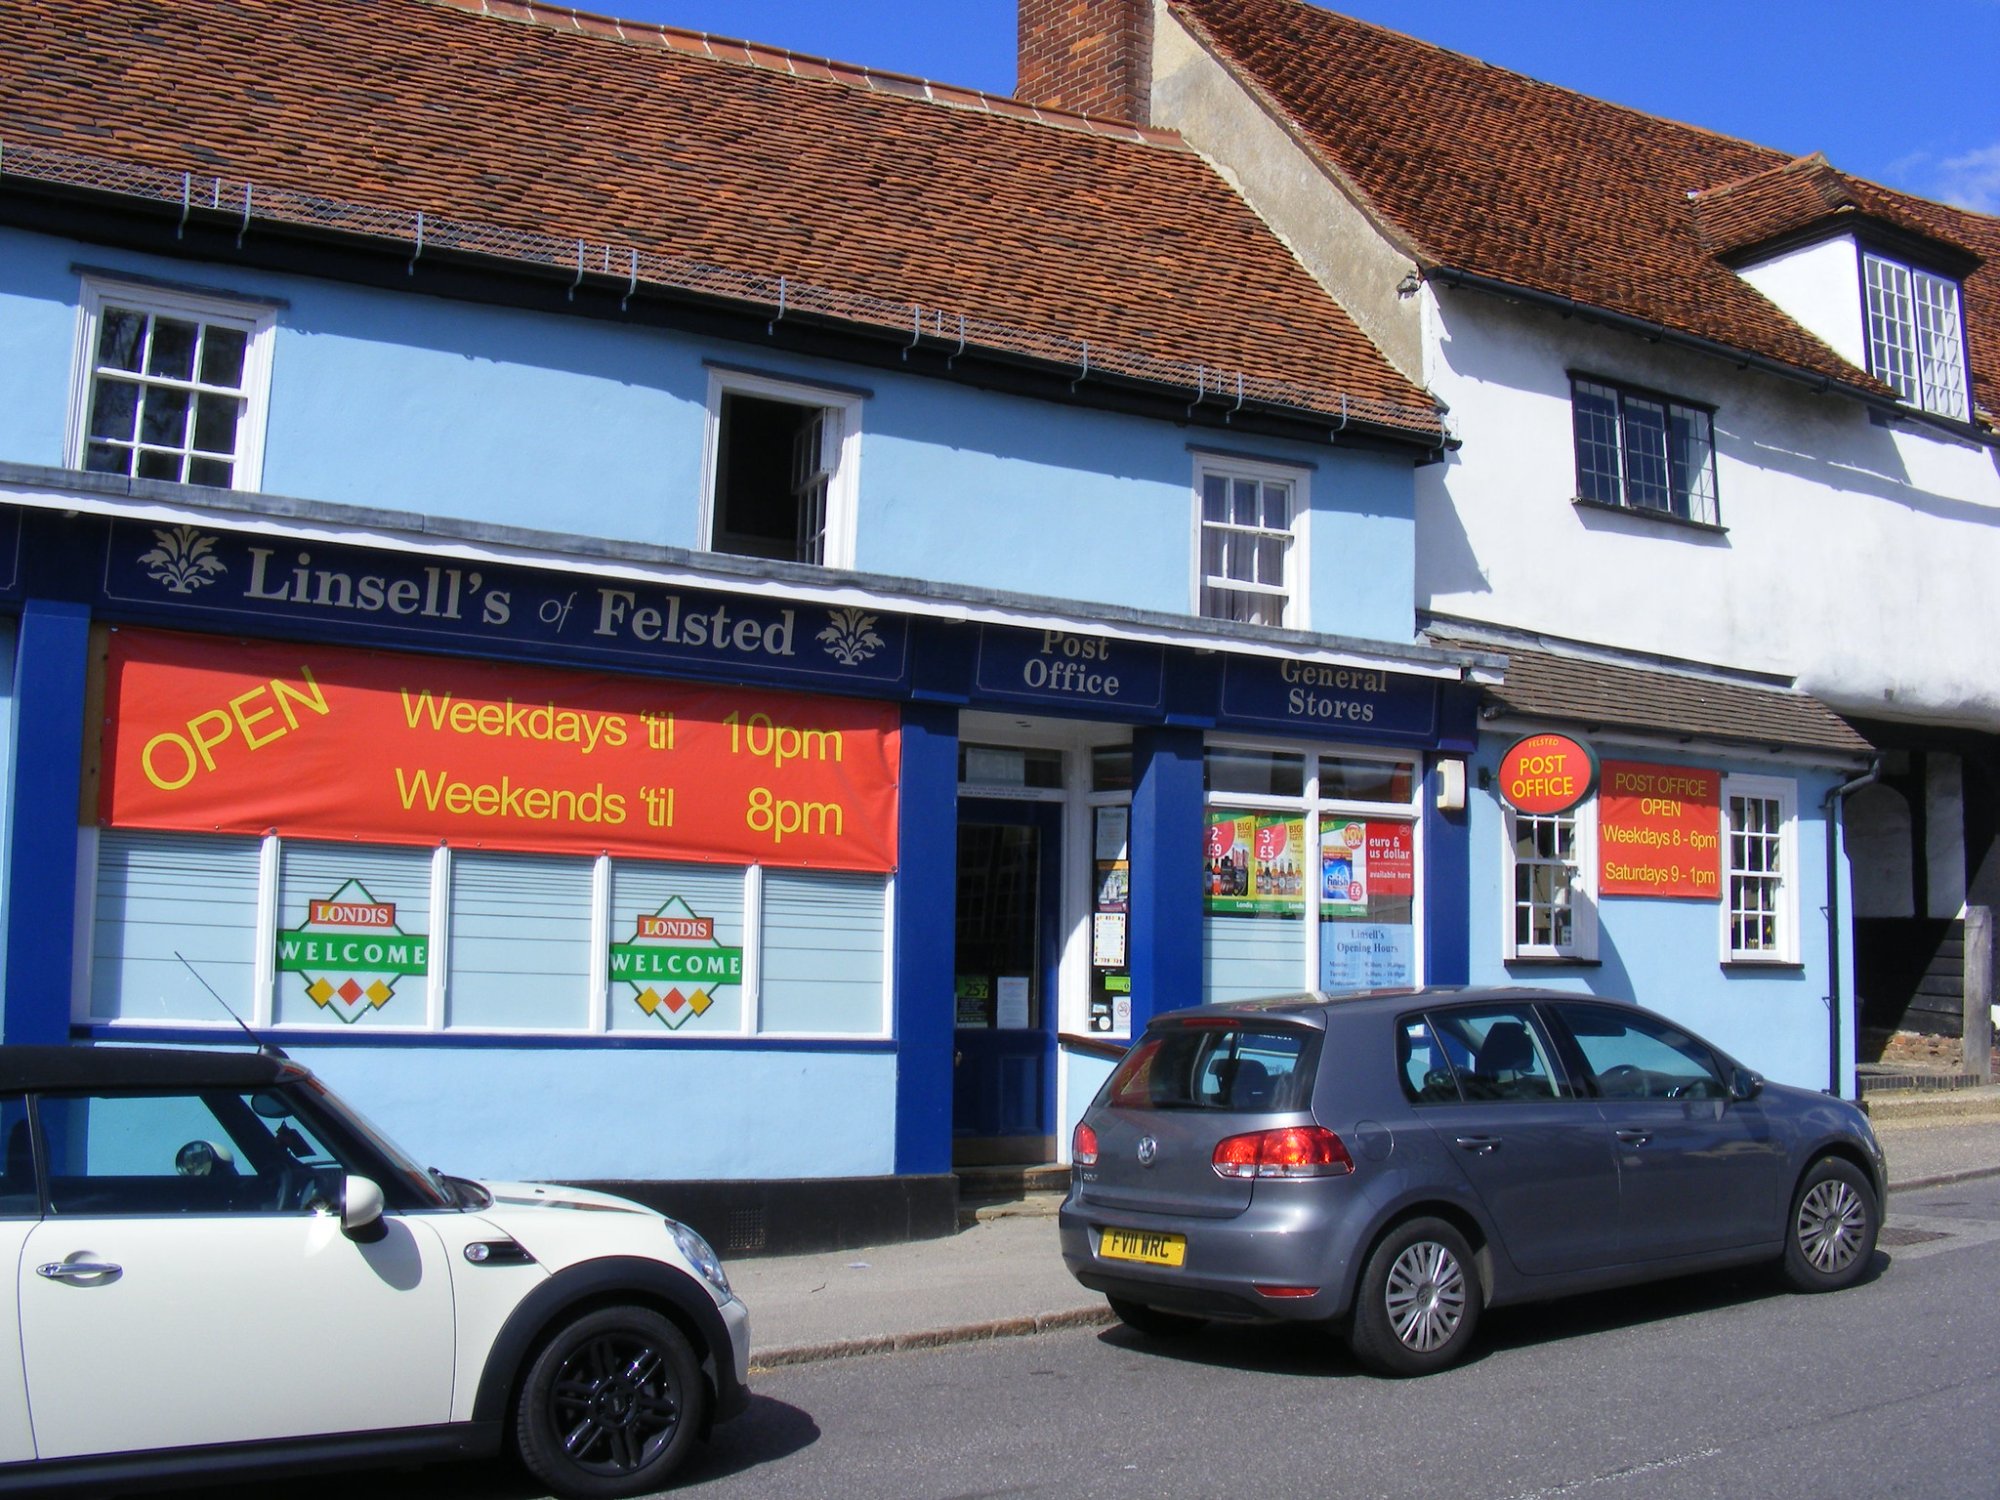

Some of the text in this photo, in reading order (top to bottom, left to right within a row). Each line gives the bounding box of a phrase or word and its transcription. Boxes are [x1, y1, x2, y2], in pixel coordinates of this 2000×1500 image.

[243, 547, 796, 656] Linsell's of Felsted
[1041, 630, 1109, 661] Post
[1023, 659, 1120, 696] Office
[1281, 659, 1387, 692] General
[1288, 688, 1374, 722] Stores
[142, 664, 330, 790] OPEN
[401, 687, 843, 768] Weekdays 'til 10pm
[1528, 738, 1560, 748] FELSTED
[1520, 755, 1567, 776] POST
[1512, 776, 1574, 798] OFFICE
[1615, 773, 1708, 797] POST OFFICE
[395, 767, 843, 843] Weekends 'til 8pm
[1641, 798, 1681, 816] OPEN
[1369, 836, 1400, 848] euro &
[1602, 824, 1670, 849] Weekdays
[1672, 829, 1681, 846] 8
[1690, 830, 1717, 851] 6pm
[1260, 846, 1275, 858] £5
[1369, 849, 1410, 859] us dollar
[1327, 874, 1349, 886] finish
[1369, 870, 1411, 879] available here
[1605, 862, 1668, 886] Saturdays
[1670, 865, 1679, 882] 9
[1690, 866, 1715, 887] 1pm
[1350, 886, 1361, 896] £6
[317, 905, 389, 924] LONDIS
[644, 920, 708, 937] LONDIS
[1351, 929, 1385, 940] Linsell's
[278, 940, 426, 965] WELCOME
[1336, 943, 1399, 954] Opening Hours
[611, 953, 741, 975] WELCOME
[1111, 1231, 1171, 1258] FV11 WRC
